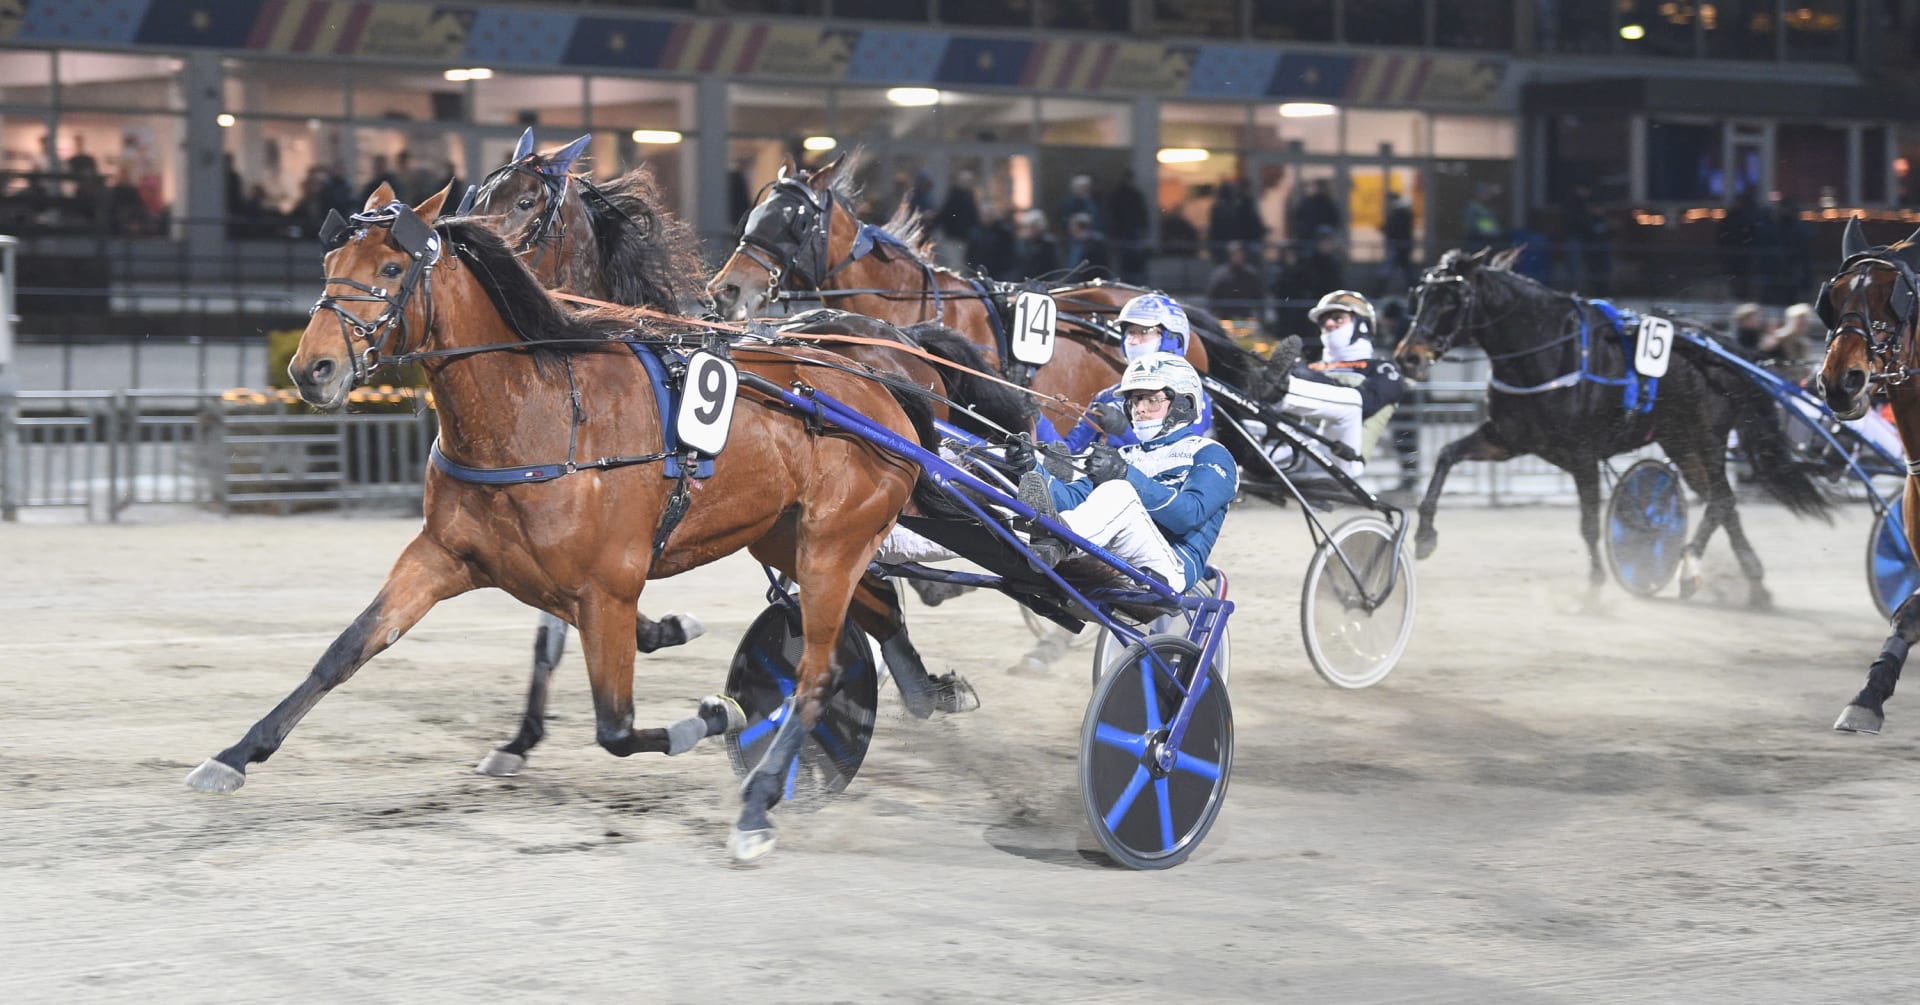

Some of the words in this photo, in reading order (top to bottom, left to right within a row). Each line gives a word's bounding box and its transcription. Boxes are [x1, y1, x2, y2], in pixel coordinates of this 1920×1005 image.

[1019, 295, 1050, 345] 14
[1643, 319, 1667, 359] 15
[694, 358, 727, 425] 9
